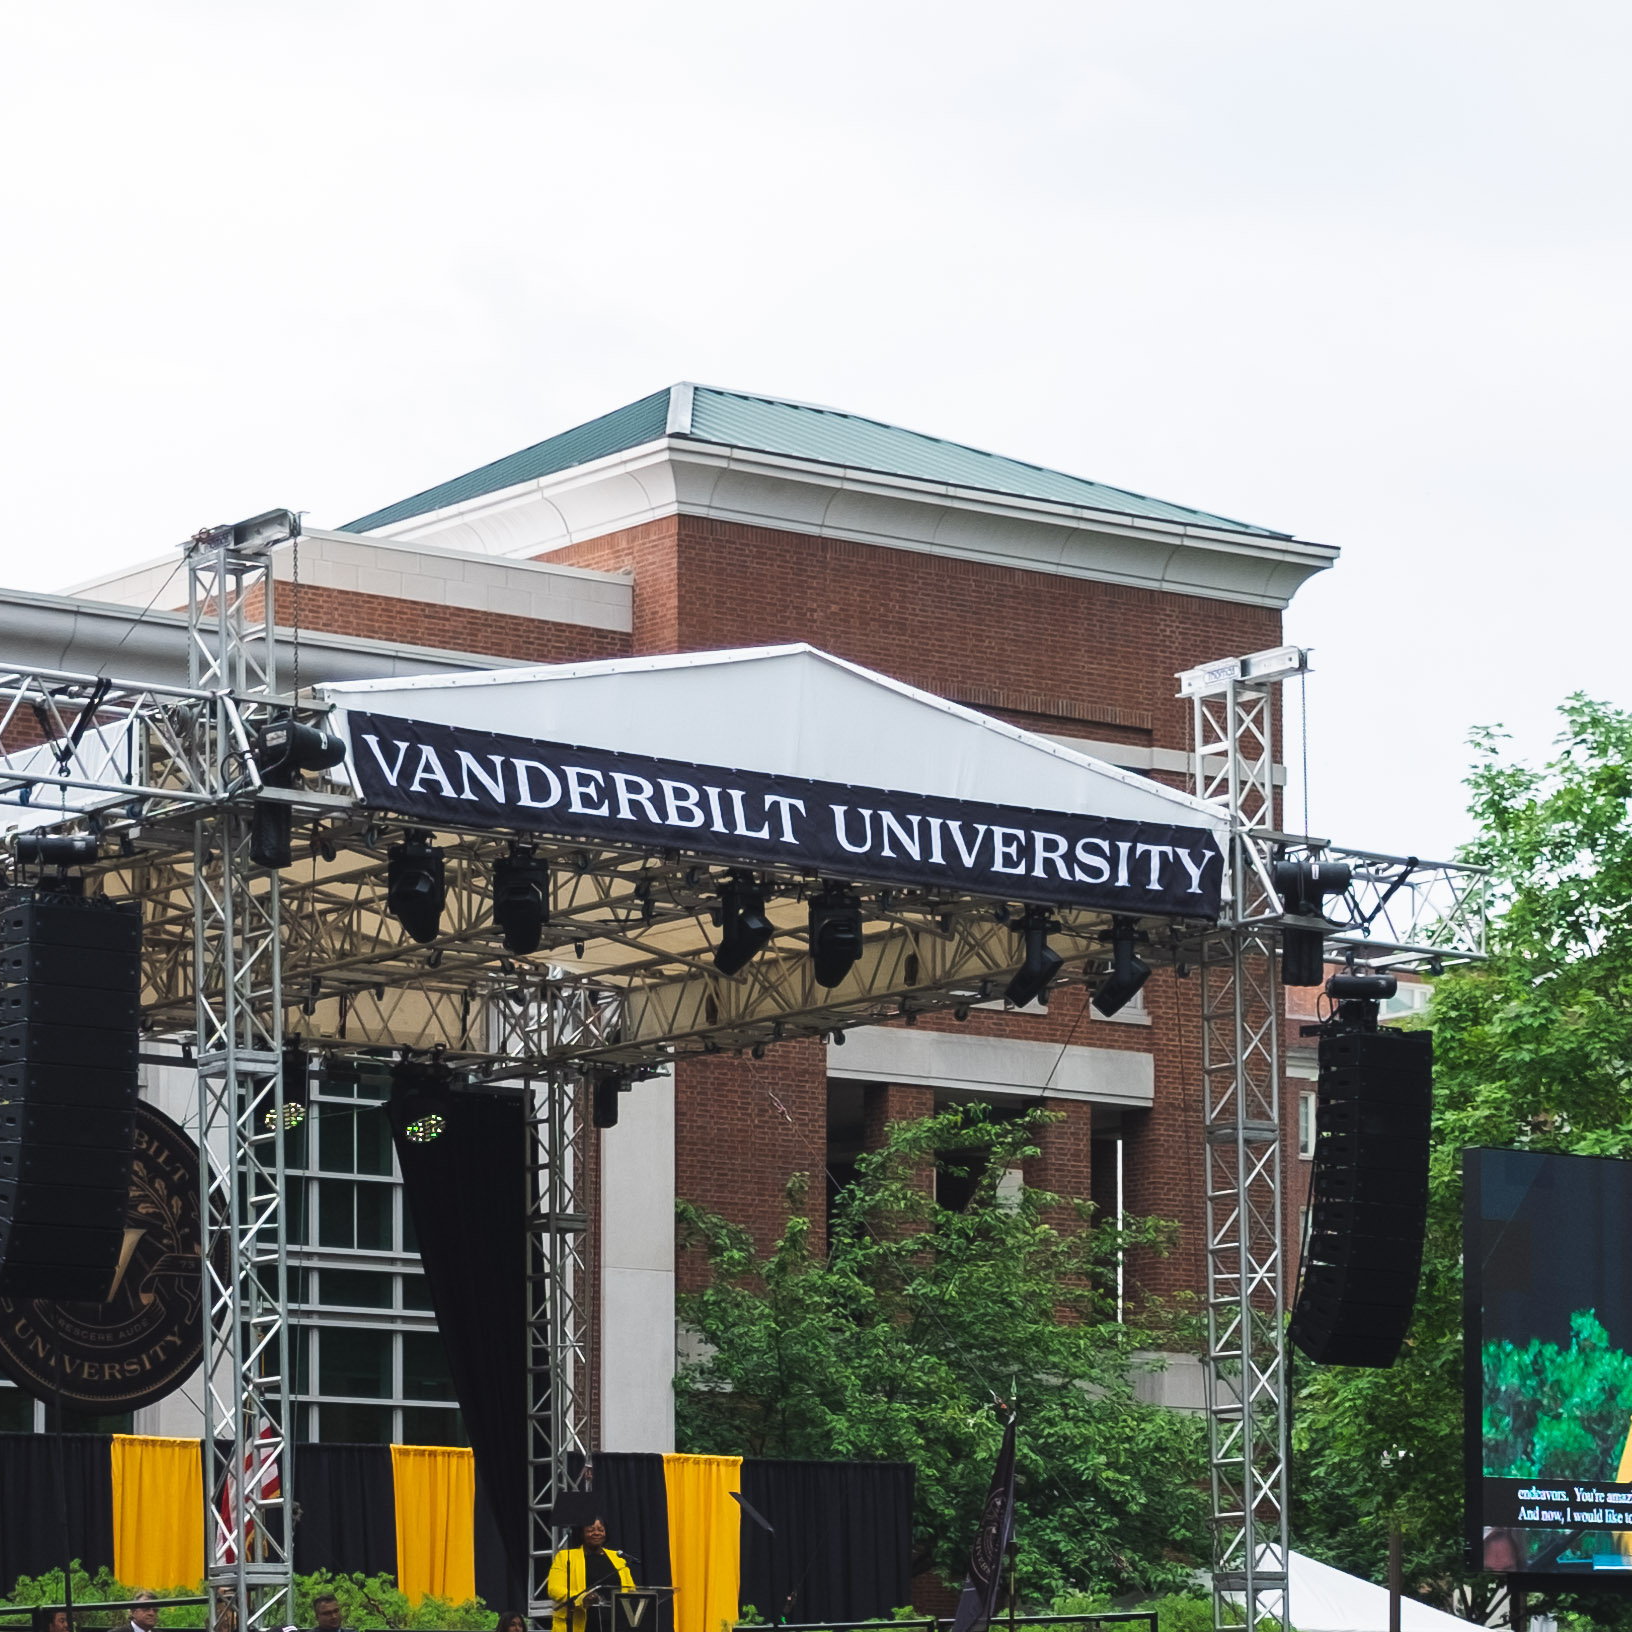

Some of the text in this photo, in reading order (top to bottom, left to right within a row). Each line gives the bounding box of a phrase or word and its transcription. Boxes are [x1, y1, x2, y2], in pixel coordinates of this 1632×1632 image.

[360, 734, 1216, 894] VANDERBILT UNIVERSITY
[57, 1317, 114, 1342] RESCERE
[15, 1319, 184, 1381] UNIVERSITY
[1518, 1486, 1569, 1501] endeavors.
[1574, 1487, 1605, 1503] You're
[1518, 1506, 1539, 1520] And
[1541, 1511, 1564, 1524] now,
[1573, 1508, 1603, 1523] would
[1605, 1509, 1623, 1523] like
[620, 1598, 649, 1628] V
